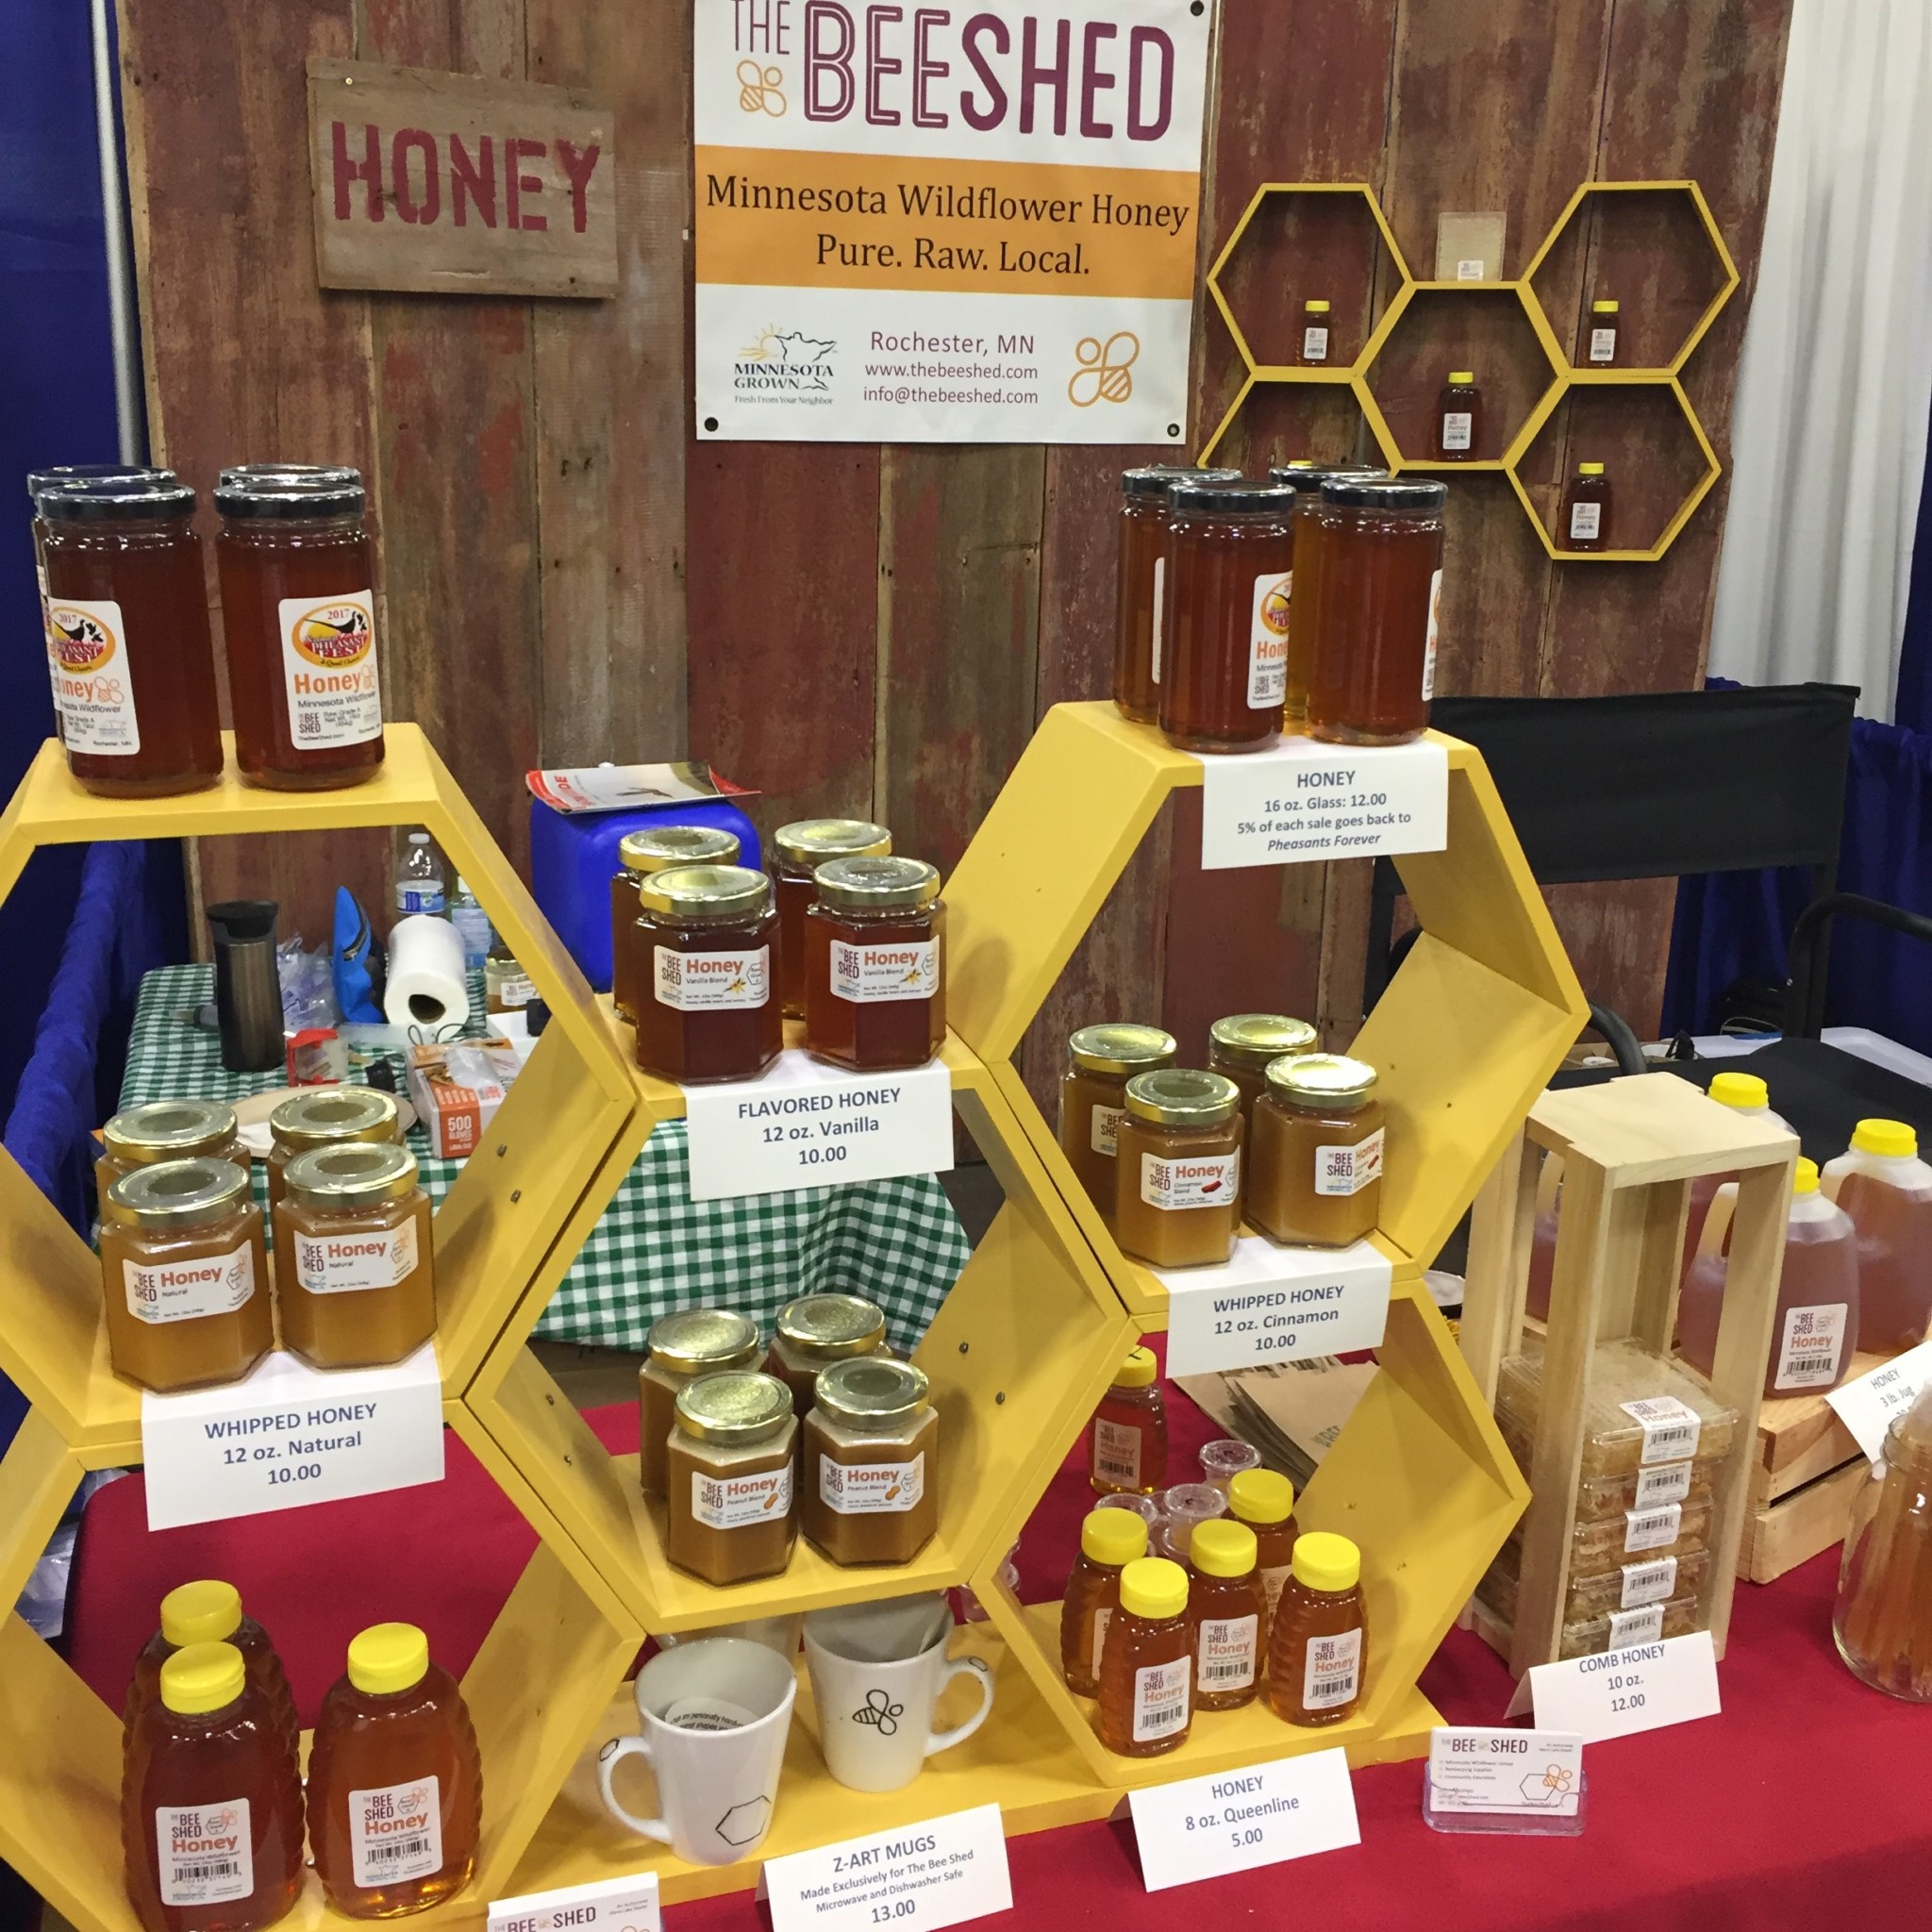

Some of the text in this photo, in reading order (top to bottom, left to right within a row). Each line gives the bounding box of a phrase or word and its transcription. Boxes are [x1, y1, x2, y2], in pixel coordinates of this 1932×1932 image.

[731, 0, 790, 56] THE
[331, 121, 601, 234] HONEY
[707, 174, 1190, 235] Minnesota Wildflower Honey
[817, 234, 1091, 275] Pure. Raw. Local.
[871, 331, 1034, 358] Rochester, MN
[734, 363, 834, 377] MINNESOTA
[865, 362, 1038, 379] www.thebeeshed.com
[734, 377, 800, 390] GROWN
[735, 395, 756, 404] Fresh
[779, 396, 797, 405] Your
[798, 396, 834, 407] Neighbor
[863, 386, 1038, 405] info@thebeeshed.com
[59, 613, 76, 624] 2017
[327, 608, 350, 620] 2017
[311, 636, 365, 654] PHEASANT
[293, 671, 361, 694] Honey
[298, 698, 344, 708] Minnesota
[304, 712, 320, 724] BEE
[299, 723, 322, 734] SHED
[1297, 771, 1356, 789] HONEY
[1264, 793, 1387, 813] 16 oz. Glass: 12.00
[1238, 812, 1411, 834] 5% of each sale goes back to
[1268, 834, 1381, 851] Pheasants Forever
[667, 956, 681, 972] BEE
[843, 949, 858, 965] BEE
[864, 951, 919, 966] Honey
[687, 959, 743, 975] Honey
[838, 961, 859, 978] SHED
[662, 968, 682, 986] SHED
[739, 1088, 901, 1119] FLAVORED HONEY
[447, 1115, 472, 1131] 500
[762, 1117, 879, 1142] 12 oz. Vanilla
[798, 1145, 847, 1165] 10.00
[1335, 1153, 1352, 1164] BEE
[1356, 1139, 1380, 1162] Honey
[1156, 1164, 1171, 1178] BEE
[1175, 1165, 1224, 1178] Honey
[1327, 1165, 1352, 1176] SHED
[1149, 1174, 1171, 1190] SHED
[328, 1242, 386, 1257] Honey
[138, 1273, 155, 1288] BEE
[160, 1267, 222, 1287] Honey
[162, 1289, 188, 1297] Natural
[1213, 1286, 1344, 1313] WHIPPED HONEY
[1214, 1309, 1339, 1335] 12 oz. Cinnamon
[1793, 1324, 1812, 1335] SHED
[1255, 1334, 1296, 1351] 10.00
[1790, 1336, 1833, 1348] Honey
[1871, 1368, 1900, 1390] HONEY
[1880, 1396, 1889, 1407] 3
[1898, 1386, 1915, 1399] Jug
[205, 1403, 377, 1440] WHIPPED HONEY
[224, 1431, 361, 1464] 12 oz. Natural
[268, 1464, 322, 1485] 10.00
[848, 1470, 899, 1483] Honey
[707, 1482, 722, 1497] BEE
[727, 1478, 777, 1496] Honey
[701, 1491, 723, 1508] SHED
[1214, 1625, 1227, 1634] BEE
[1208, 1634, 1227, 1643] SHED
[1322, 1642, 1335, 1652] BEE
[1208, 1641, 1250, 1655] Honey
[1315, 1651, 1335, 1660] SHED
[1315, 1657, 1354, 1672] Honey
[1579, 1644, 1665, 1674] COMB HONEY
[1144, 1680, 1163, 1690] SHED
[1607, 1675, 1644, 1690] 10 oz.
[1145, 1685, 1184, 1703] Honey
[1611, 1693, 1645, 1712] 12.00
[1452, 1739, 1476, 1752] BEE
[1491, 1740, 1527, 1754] SHED
[1211, 1776, 1263, 1799] HONEY
[373, 1793, 392, 1807] BEE
[180, 1813, 200, 1825] BEE
[365, 1807, 393, 1821] SHED
[1186, 1796, 1299, 1831] 8 oz. Queenline
[172, 1825, 201, 1839] SHED
[365, 1812, 427, 1836] Honey
[172, 1835, 238, 1853] Honey
[1231, 1827, 1263, 1847] 5.00
[833, 1835, 936, 1873] Z-ART MUGS
[801, 1849, 974, 1900] Made Exclusively for The Bee Shed
[816, 1869, 963, 1912] Microwave and Dishwasher Safe
[553, 1907, 596, 1928] SHED
[872, 1899, 916, 1923] 13.00
